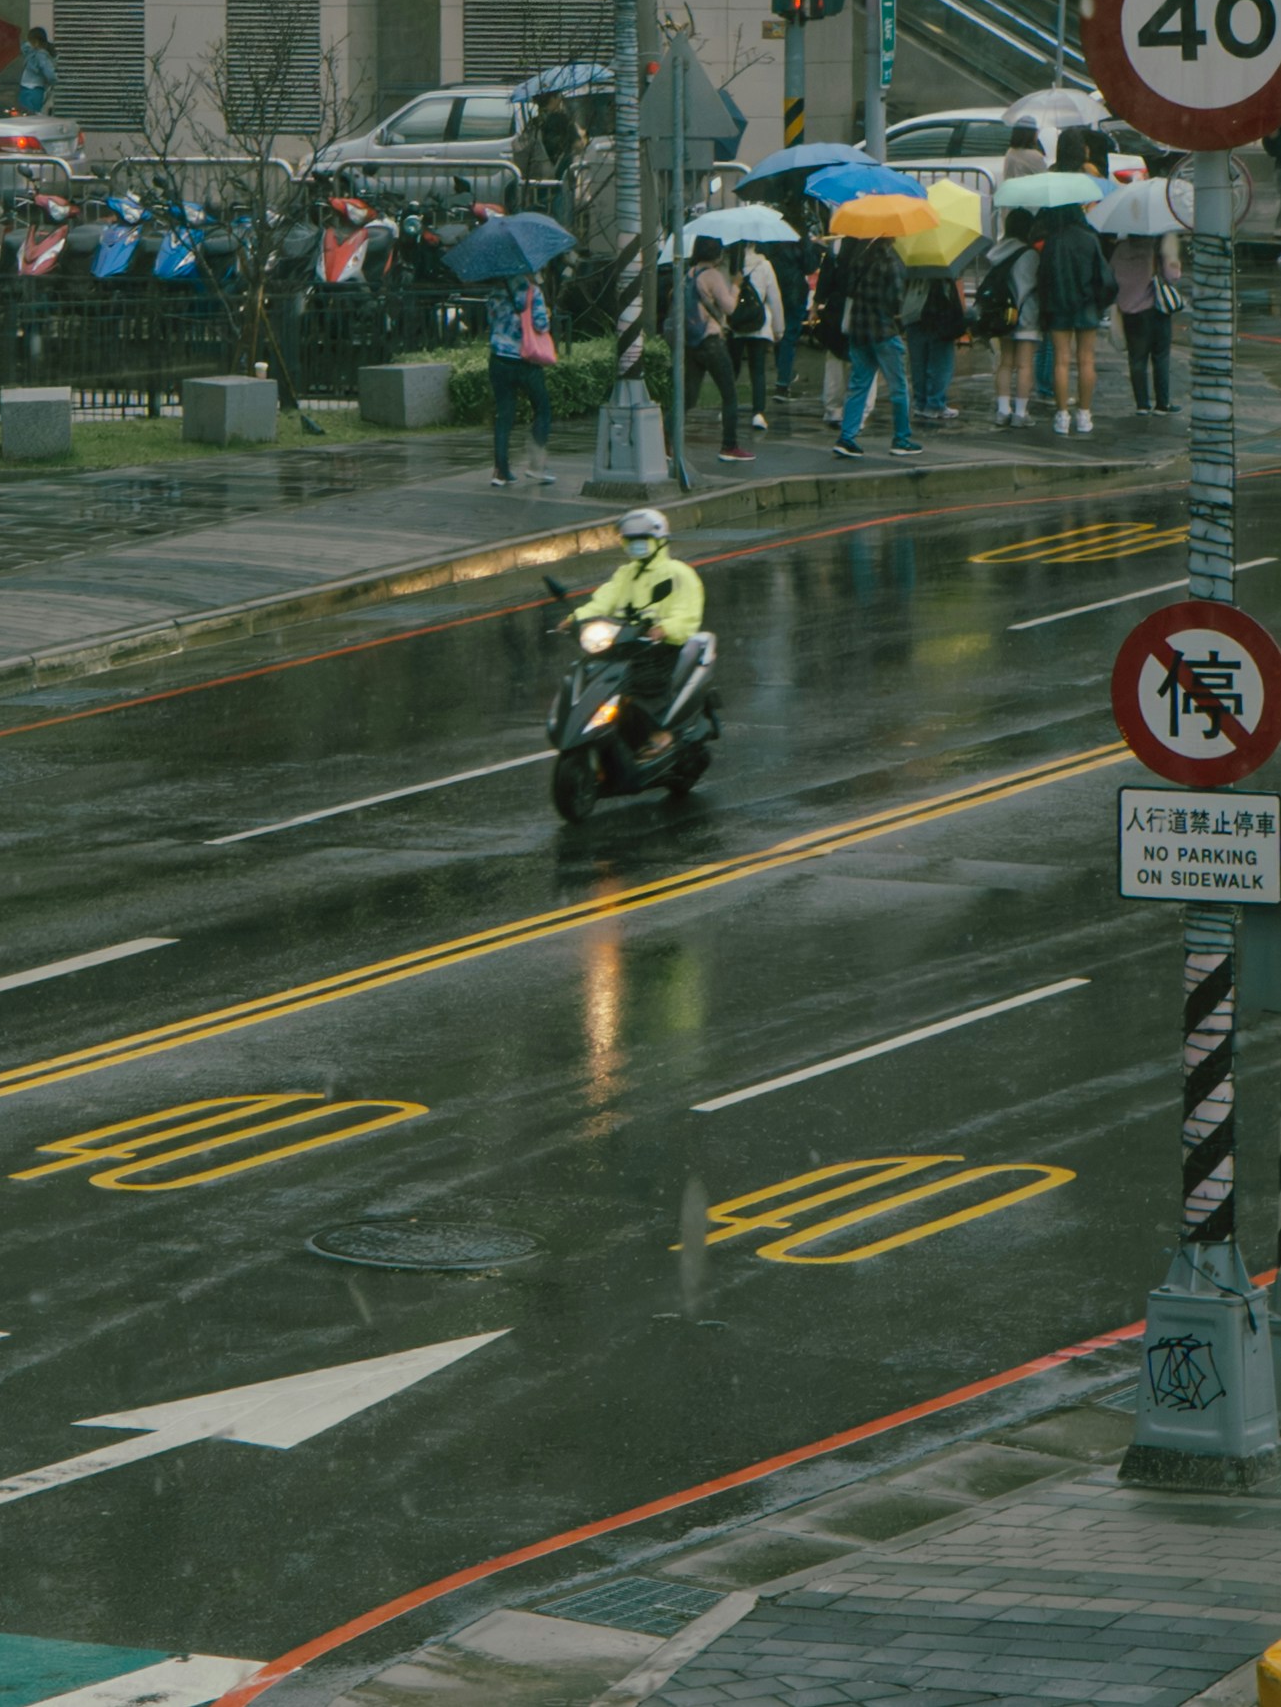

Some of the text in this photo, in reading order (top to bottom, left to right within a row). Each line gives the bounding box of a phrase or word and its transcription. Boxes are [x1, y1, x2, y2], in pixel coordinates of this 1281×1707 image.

[1156, 650, 1243, 739] 停
[1126, 807, 1276, 838] 人行道禁止停車
[1137, 869, 1264, 890] ON SIDEWALK
[1143, 846, 1257, 865] NO PARKING
[7, 1089, 430, 1191] 40
[668, 1154, 1077, 1264] 40
